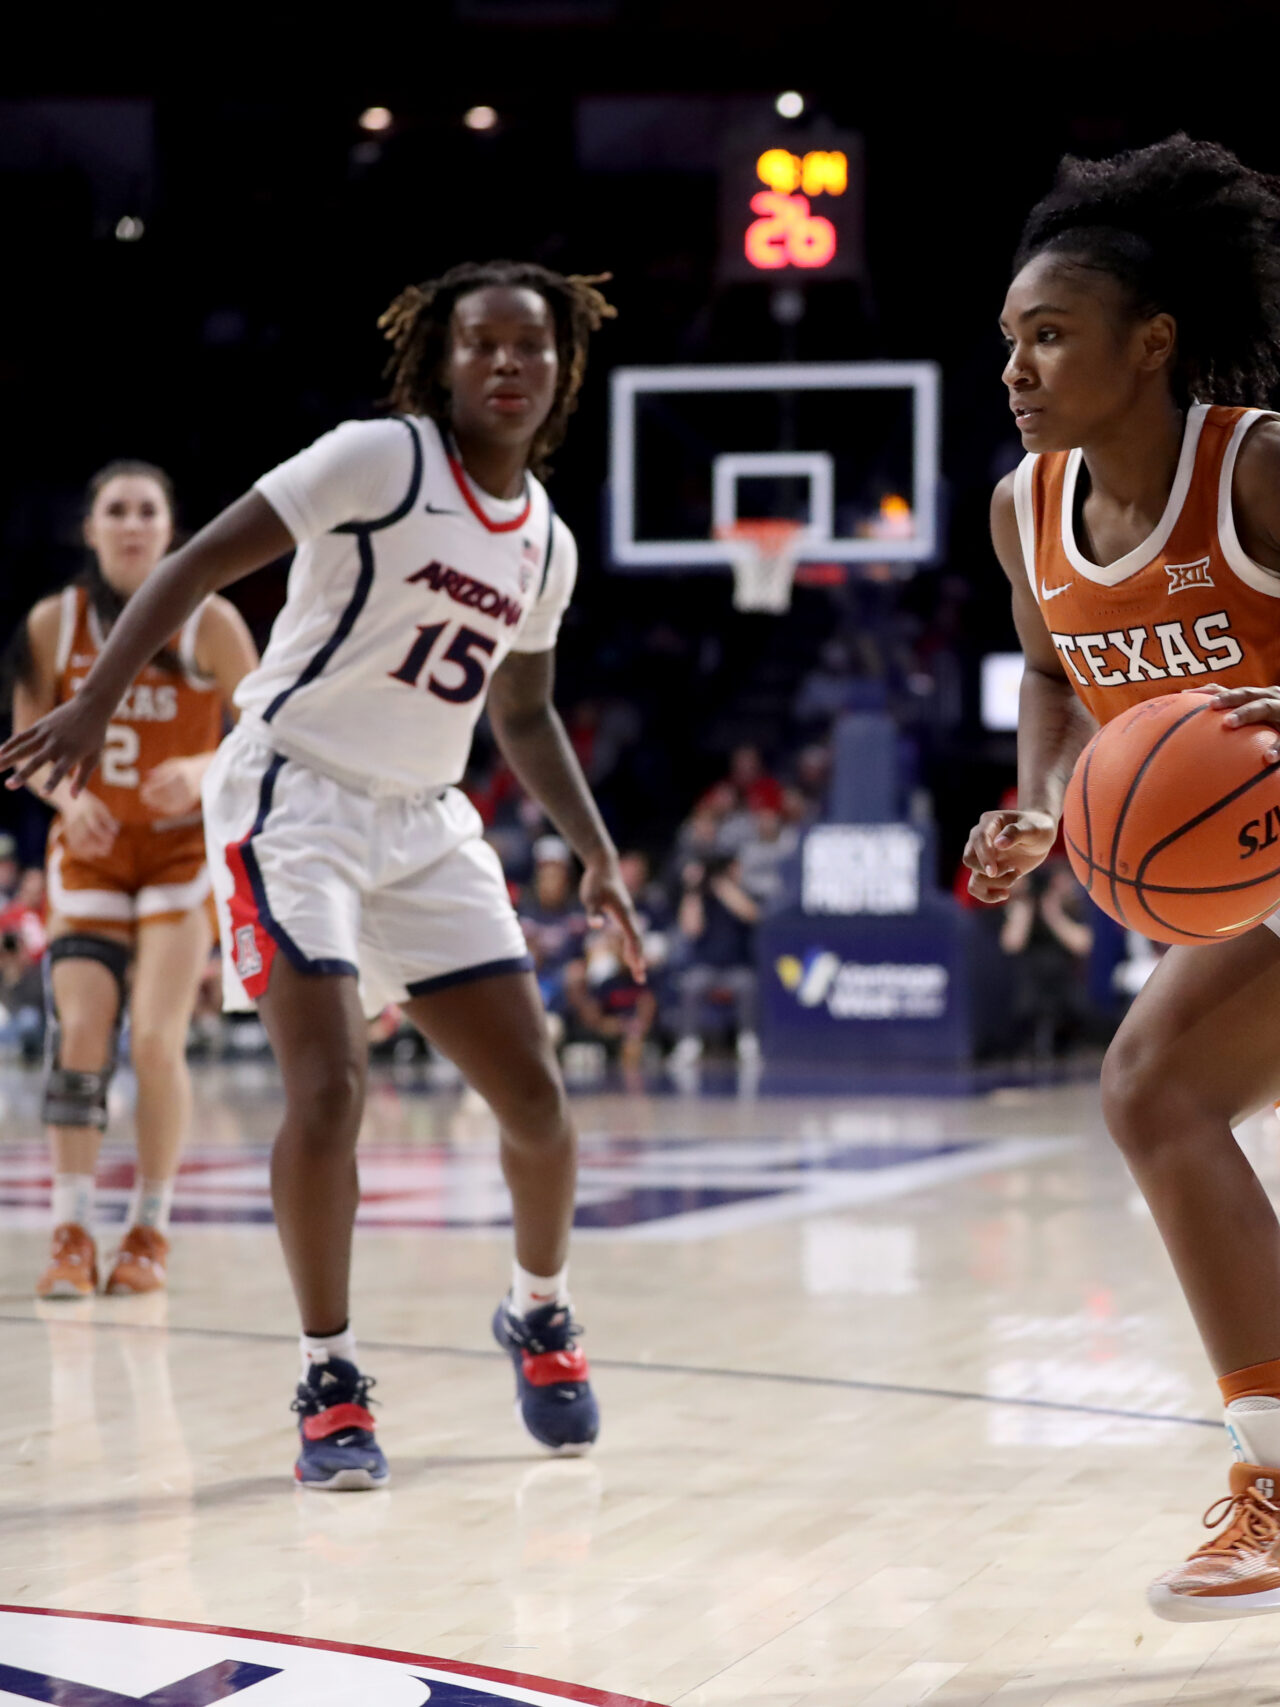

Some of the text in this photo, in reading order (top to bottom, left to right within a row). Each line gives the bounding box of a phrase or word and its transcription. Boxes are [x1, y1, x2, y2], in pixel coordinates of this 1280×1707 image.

[745, 191, 837, 269] 26
[404, 559, 523, 627] ARIZON
[386, 618, 499, 704] 15
[1050, 610, 1245, 687] TEXAS
[102, 724, 140, 789] 2
